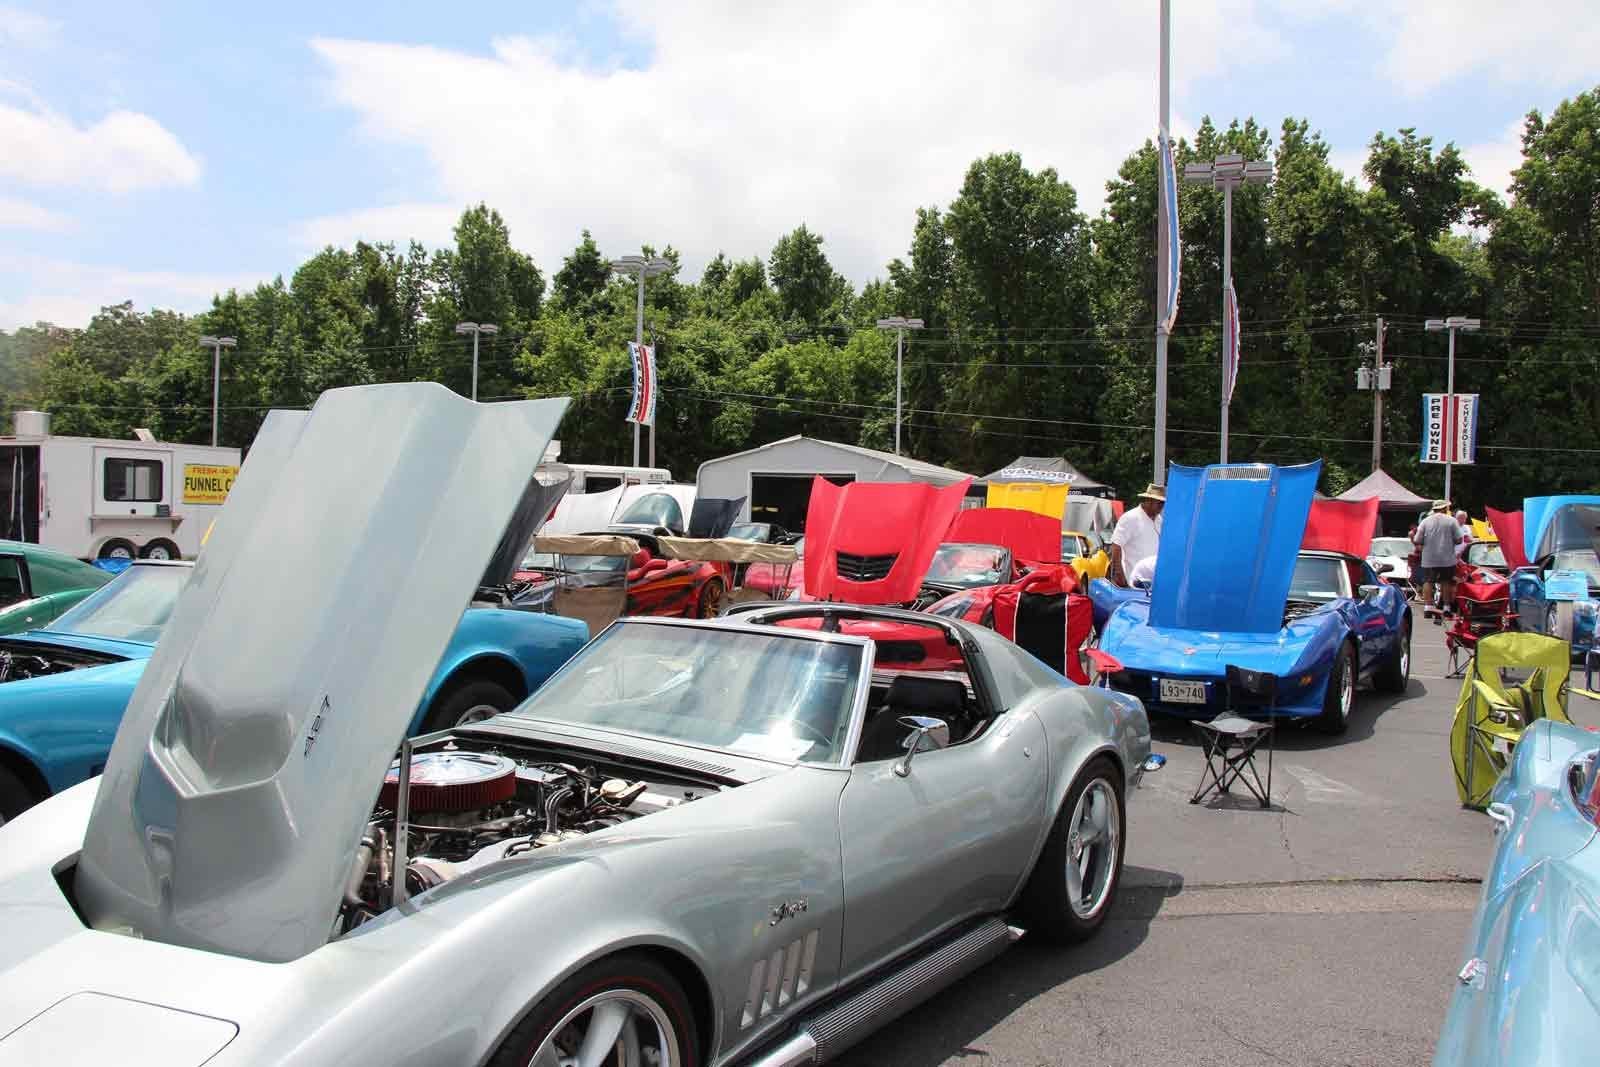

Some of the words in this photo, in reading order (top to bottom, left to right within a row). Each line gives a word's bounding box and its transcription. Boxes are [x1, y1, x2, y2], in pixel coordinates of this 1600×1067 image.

[1431, 398, 1440, 419] PRE
[1429, 422, 1441, 461] OWNED
[184, 477, 224, 492] FUNNEL
[304, 695, 330, 759] 427
